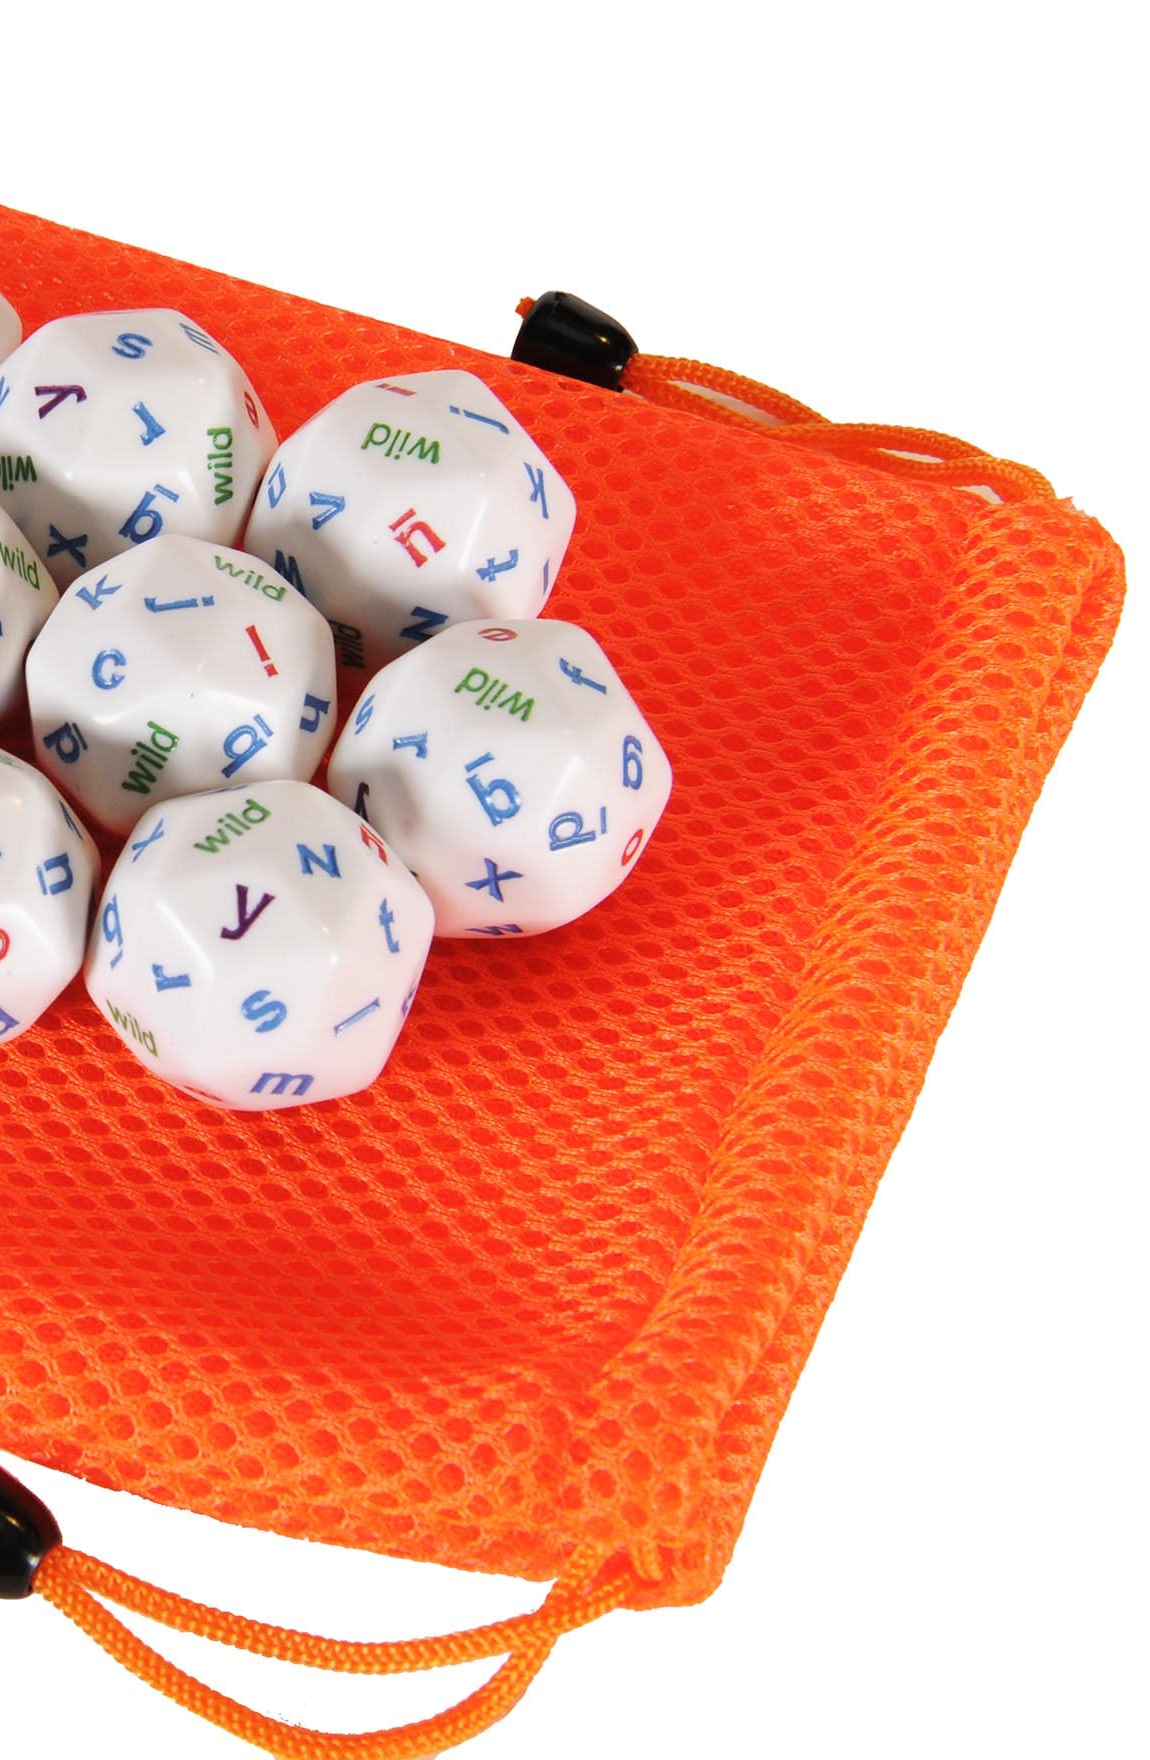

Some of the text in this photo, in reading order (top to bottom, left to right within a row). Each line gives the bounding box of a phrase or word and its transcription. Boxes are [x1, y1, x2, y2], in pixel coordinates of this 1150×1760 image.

[206, 427, 234, 506] wild
[360, 422, 441, 464] wild
[213, 554, 287, 603] wild
[454, 666, 536, 722] wild
[121, 720, 179, 795] wild
[193, 798, 272, 855] wild
[621, 828, 644, 866] o
[106, 998, 158, 1058] wild
